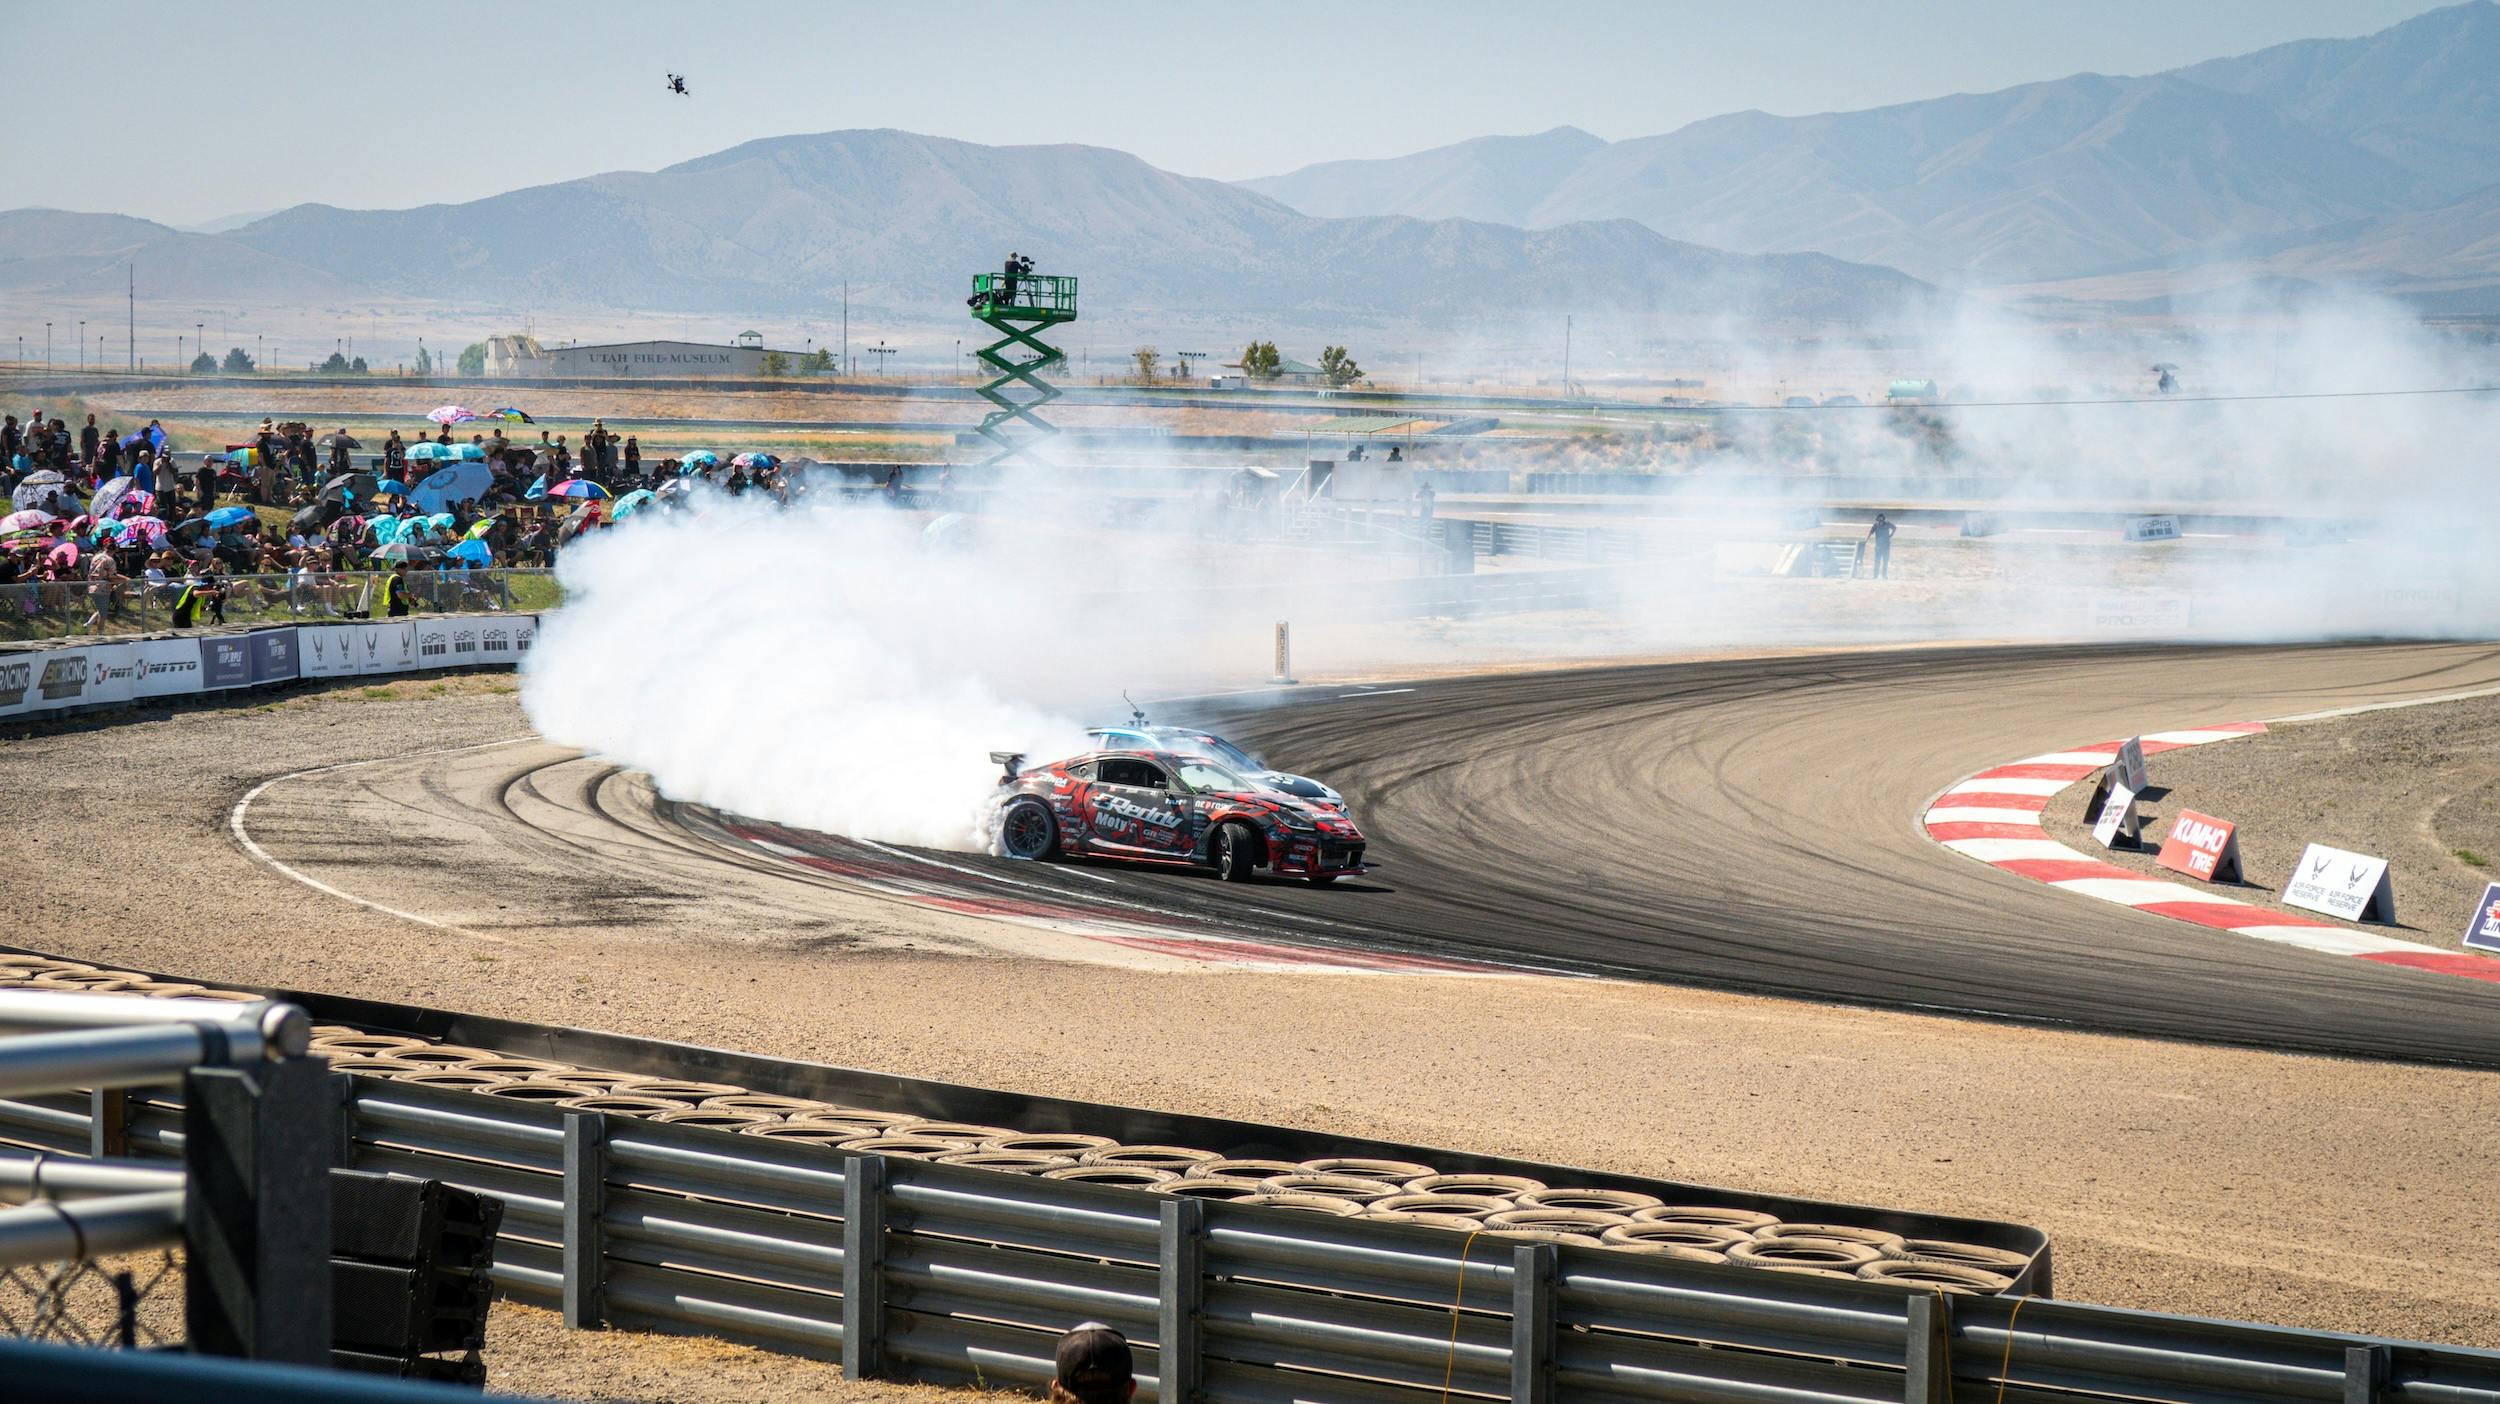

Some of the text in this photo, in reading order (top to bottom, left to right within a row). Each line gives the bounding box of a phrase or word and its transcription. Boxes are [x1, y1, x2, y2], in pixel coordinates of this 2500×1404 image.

[590, 354, 730, 364] UTAH FIRE MUSEUM
[2136, 519, 2172, 529] GoPro
[421, 632, 446, 644] GoPro
[482, 629, 508, 640] GoPro
[149, 661, 197, 673] NITTO
[2172, 817, 2227, 853] KUMHO
[2188, 849, 2216, 874] TIRE
[2291, 888, 2322, 902] RESERVE
[2305, 883, 2327, 895] FORCE
[2327, 897, 2359, 912] RESERVE
[2341, 892, 2364, 905] FORCE
